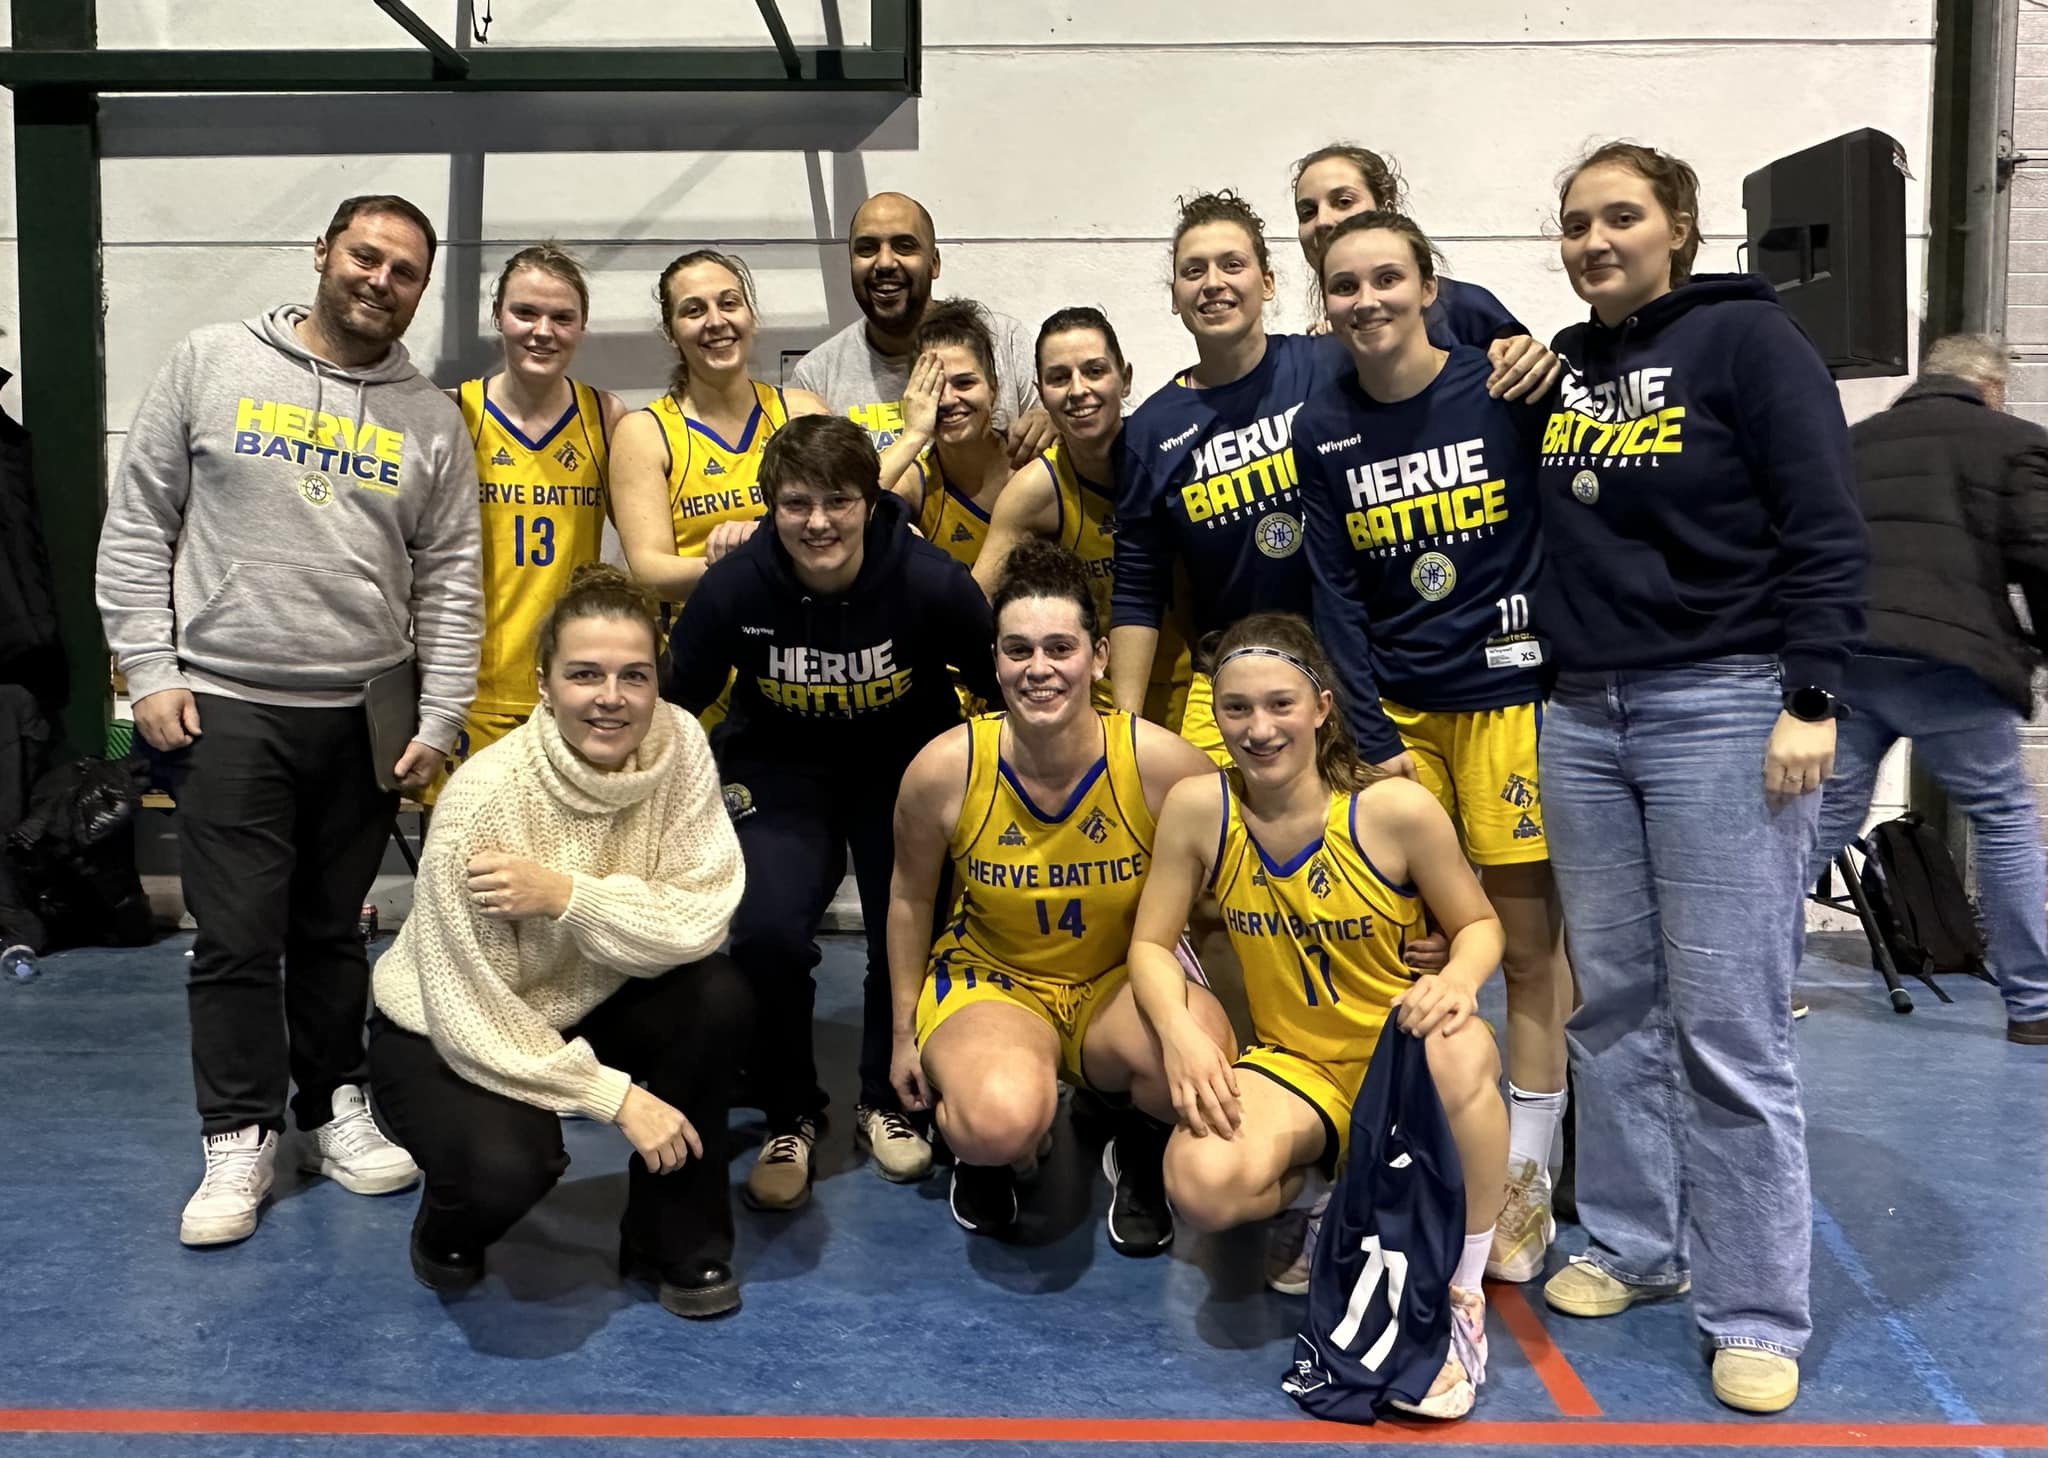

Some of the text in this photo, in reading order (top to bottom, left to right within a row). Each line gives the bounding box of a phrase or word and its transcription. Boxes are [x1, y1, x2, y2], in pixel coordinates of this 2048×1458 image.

[234, 397, 405, 463] HERVE
[1159, 423, 1199, 452] Whynot
[1317, 433, 1362, 455] Whynot
[234, 431, 400, 487] BATTICE
[1345, 437, 1489, 509] HERVE
[479, 482, 602, 506] ERVE BATTICE
[681, 488, 745, 520] HERVE
[1181, 447, 1299, 523] BATTI
[1206, 488, 1301, 529] BASKETB
[1345, 478, 1509, 551] BATTICE
[514, 514, 556, 567] 13
[1368, 526, 1496, 560] BASKETBALL
[1496, 594, 1529, 634] 10
[769, 639, 897, 684] HERVE
[1521, 651, 1537, 661] XS
[756, 667, 913, 712] BATTICE
[968, 853, 1143, 888] HERVE BATTICE
[1035, 899, 1087, 939] 14
[1226, 907, 1291, 937] HERV
